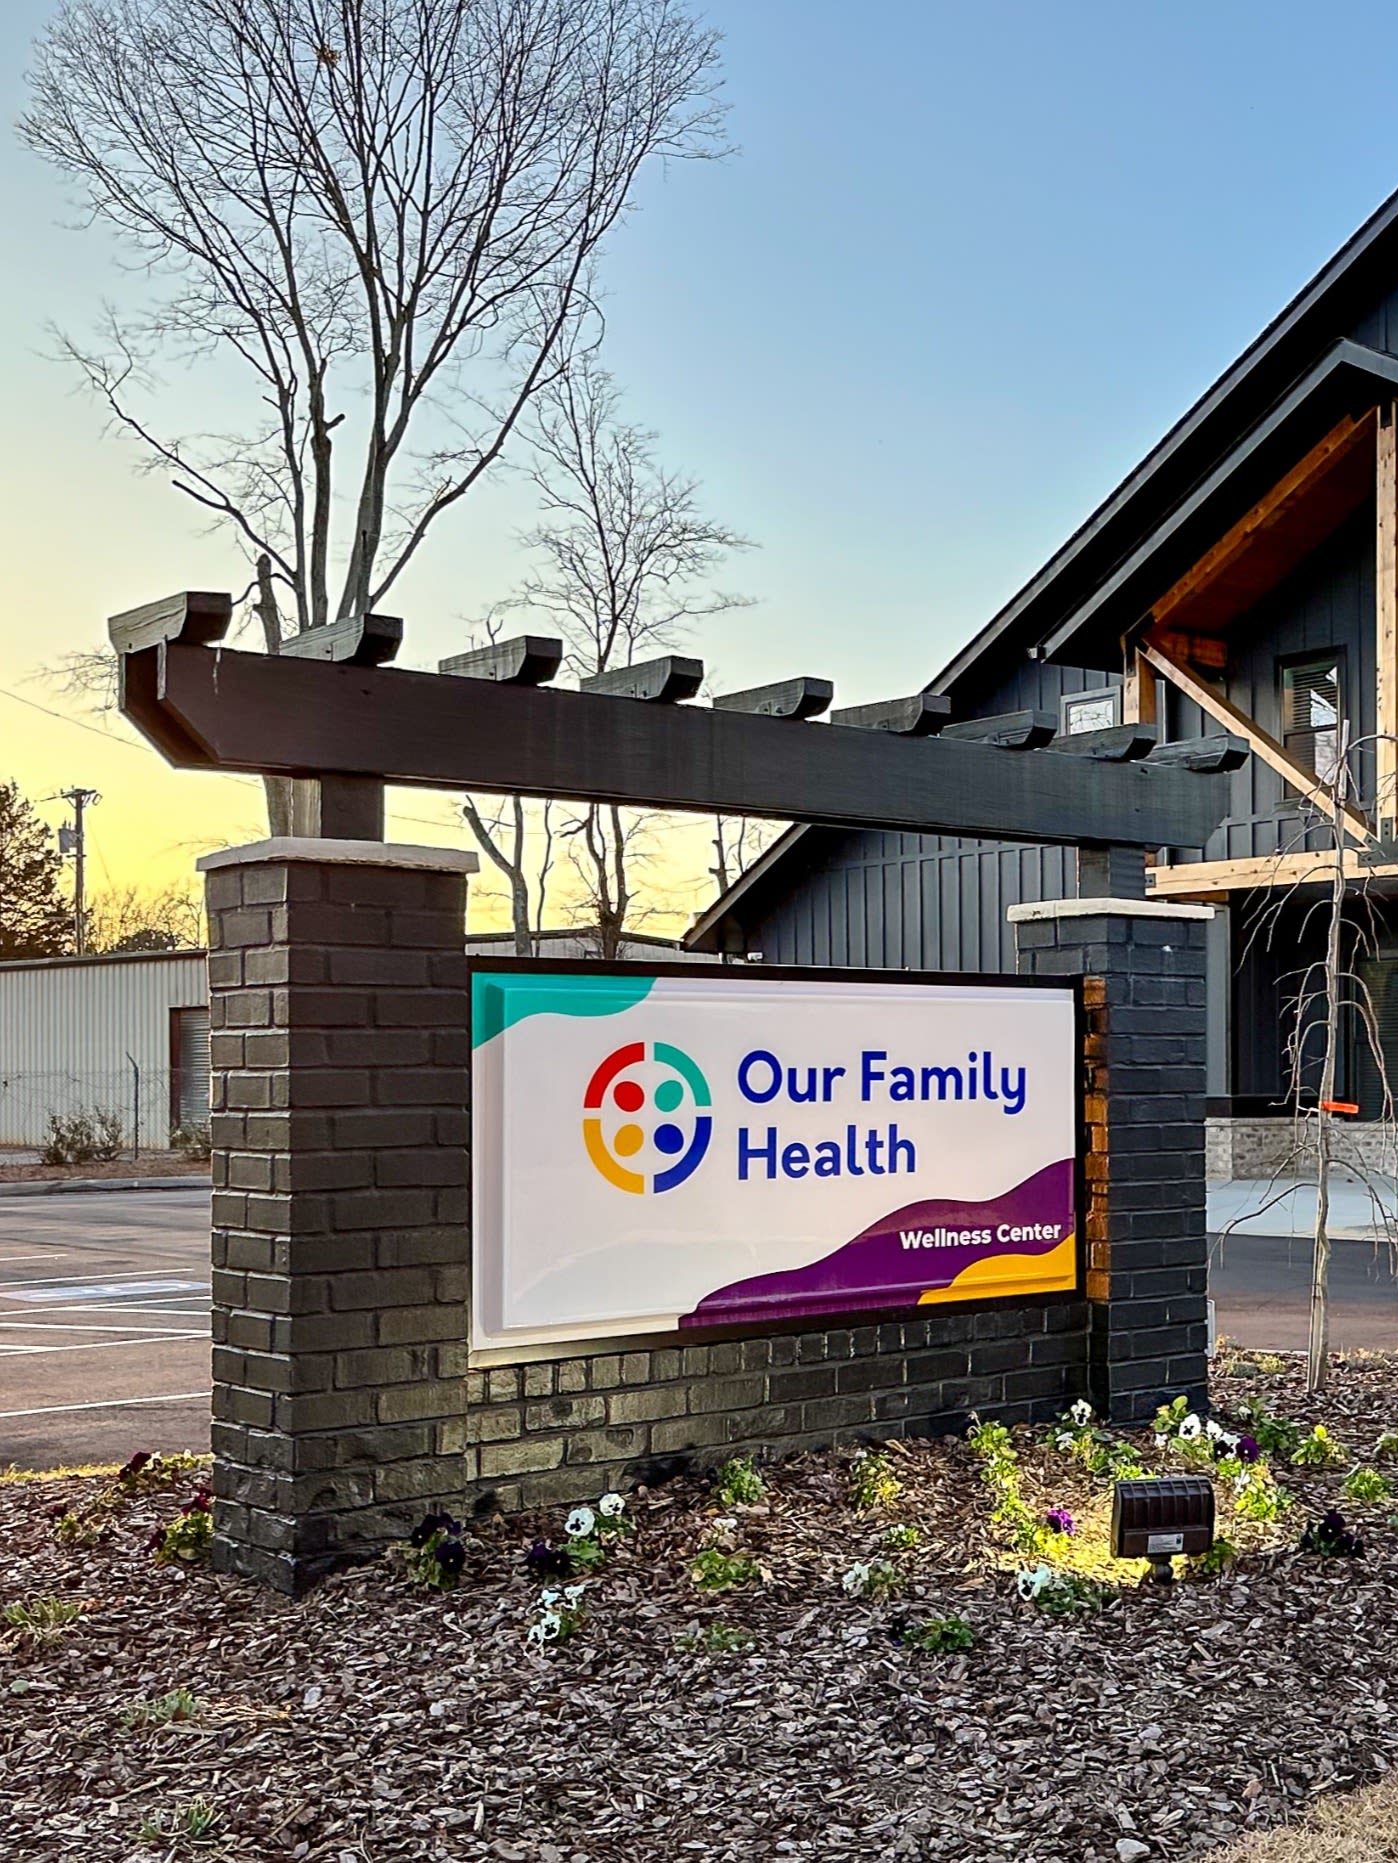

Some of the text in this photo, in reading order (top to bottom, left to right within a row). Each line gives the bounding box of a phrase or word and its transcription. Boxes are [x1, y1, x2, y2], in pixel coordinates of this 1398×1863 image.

[737, 1049, 1027, 1116] Our Family
[737, 1123, 916, 1181] Health
[899, 1223, 1062, 1250] Wellness Center
